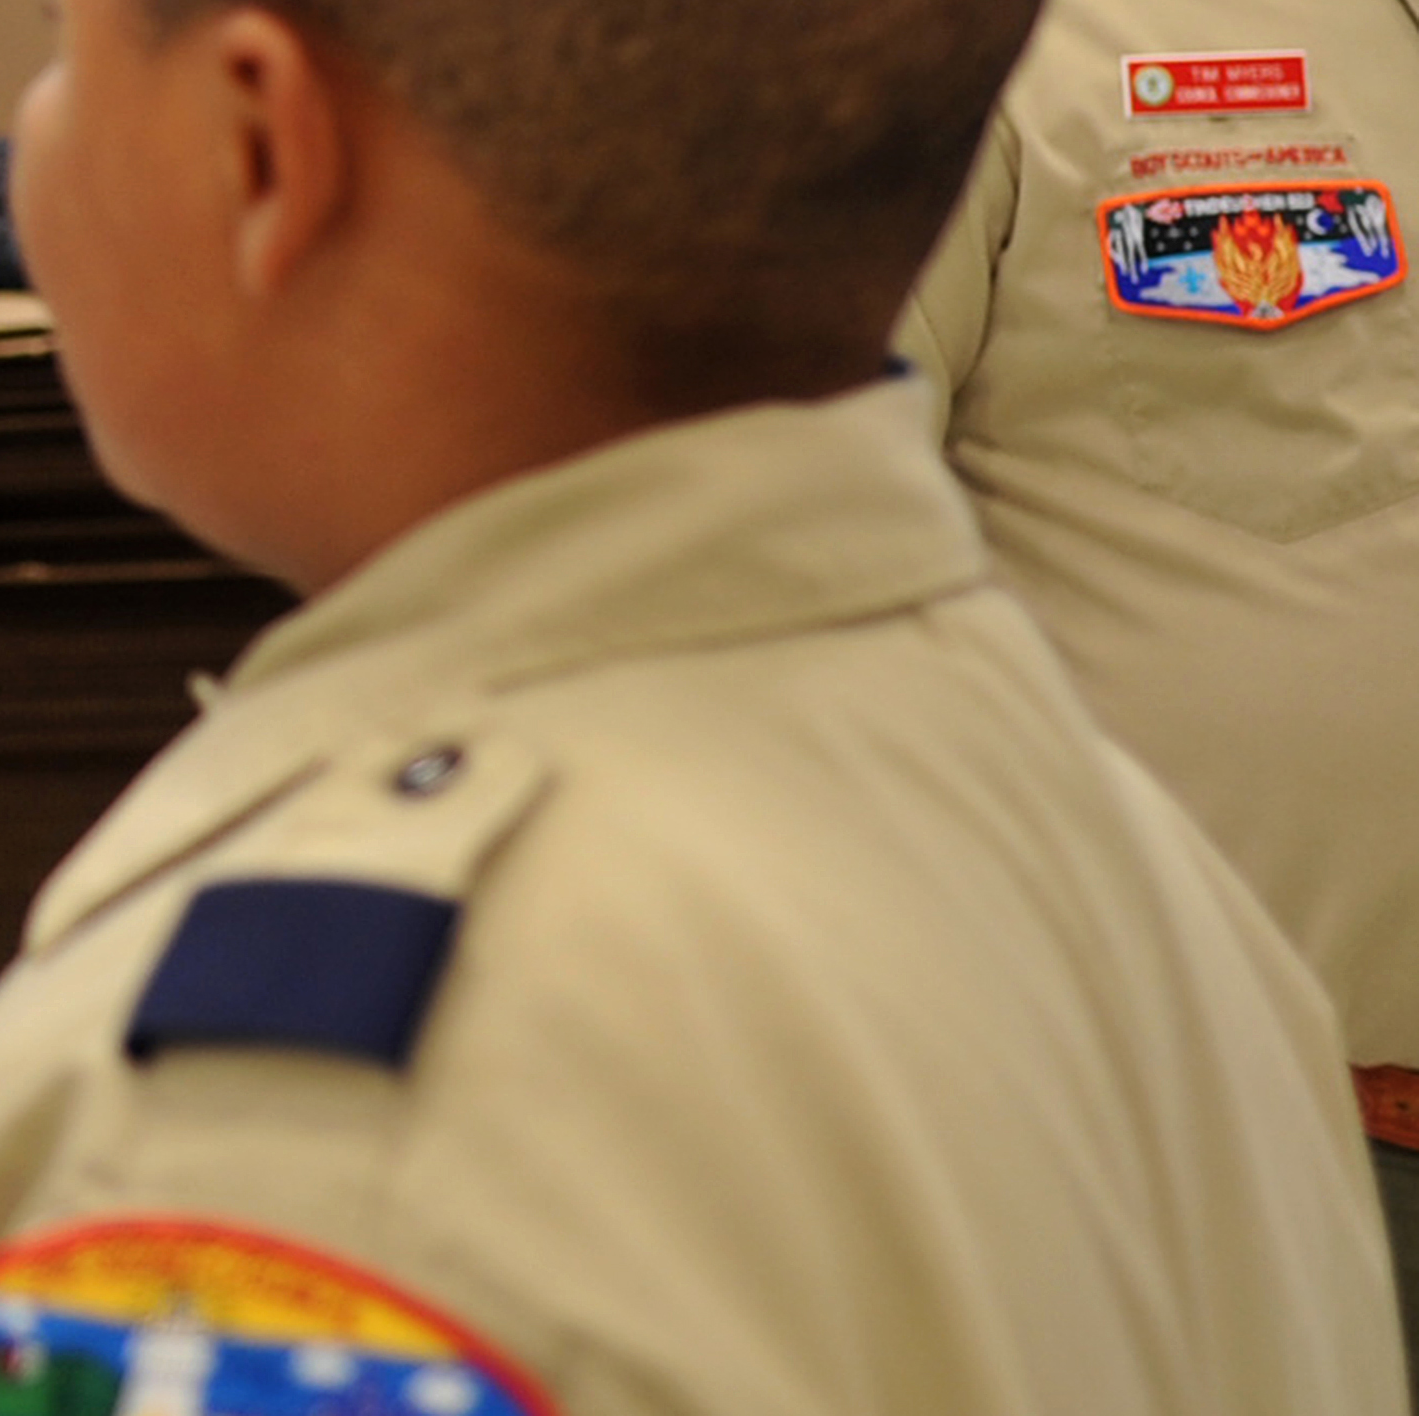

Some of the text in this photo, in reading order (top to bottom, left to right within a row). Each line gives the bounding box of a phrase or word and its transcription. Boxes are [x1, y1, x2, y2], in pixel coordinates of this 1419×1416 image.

[1130, 153, 1166, 178] BOY
[1172, 149, 1248, 170] SCOUTS
[1265, 146, 1347, 165] AMERICA
